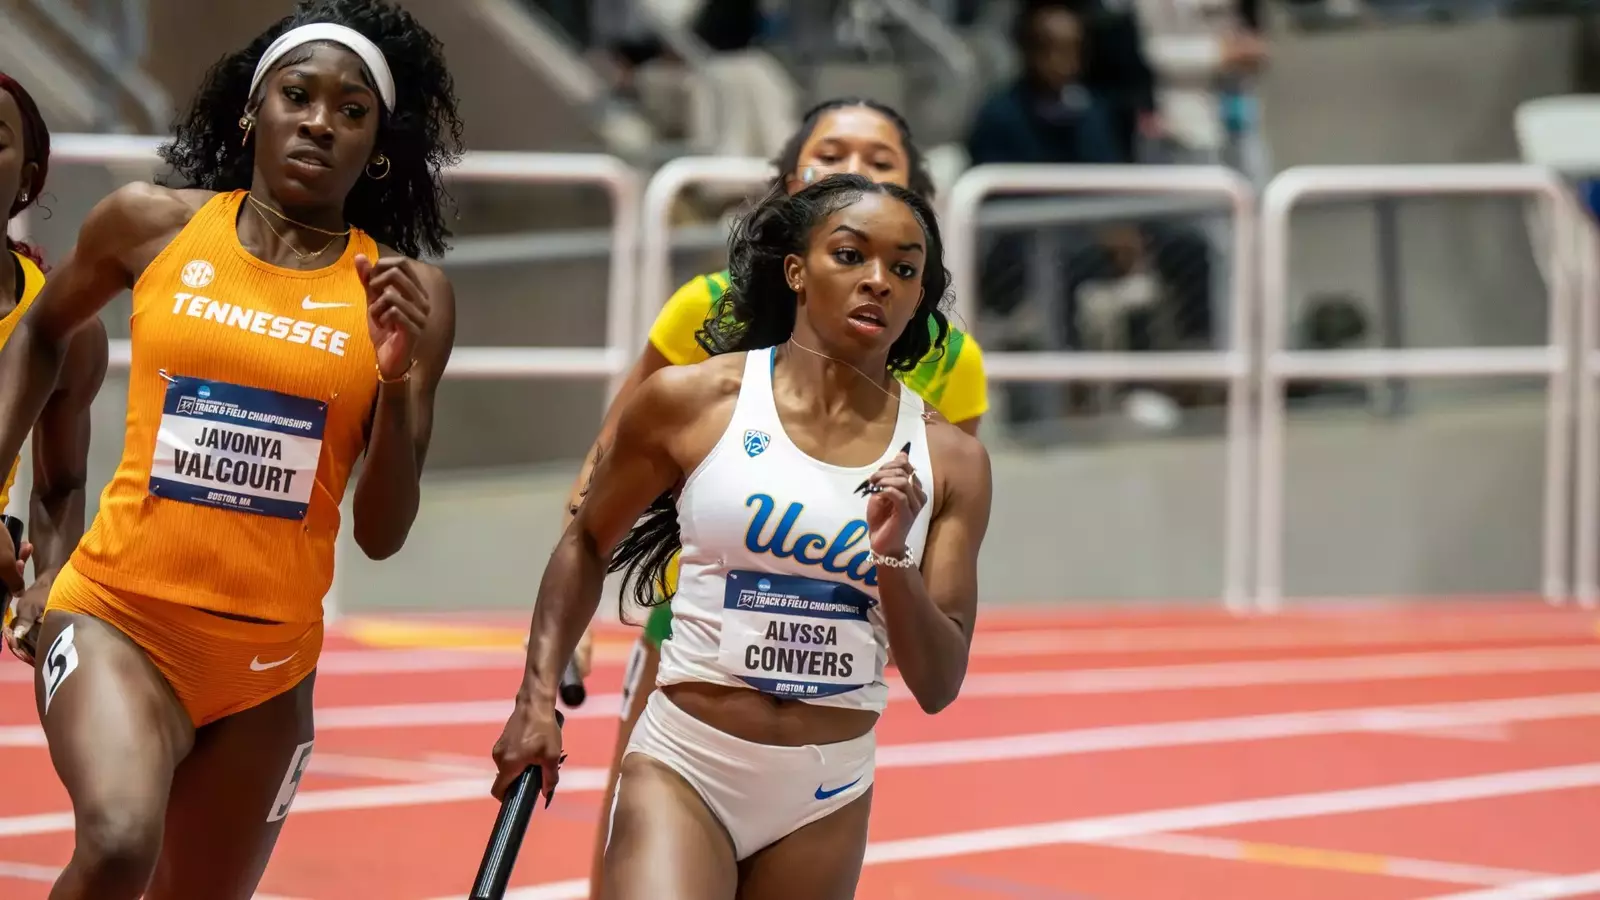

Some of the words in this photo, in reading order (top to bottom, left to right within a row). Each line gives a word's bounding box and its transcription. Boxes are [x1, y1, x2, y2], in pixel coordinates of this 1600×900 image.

[182, 261, 213, 286] SEC
[172, 292, 351, 357] TENNESSEE
[195, 403, 220, 414] TRACK
[219, 406, 226, 415] &
[225, 407, 248, 419] FIELD
[248, 410, 313, 430] CHAMPIONSHIPS
[195, 427, 282, 461] JAVONYA
[174, 448, 297, 494] VALCOURT
[239, 496, 252, 506] MA
[756, 595, 780, 607] TRACK
[780, 599, 788, 607] &
[787, 599, 809, 609] FIELD
[765, 620, 837, 646] ALYSSA
[47, 634, 67, 698] 5
[744, 645, 854, 678] CONYERS
[806, 685, 819, 694] MA
